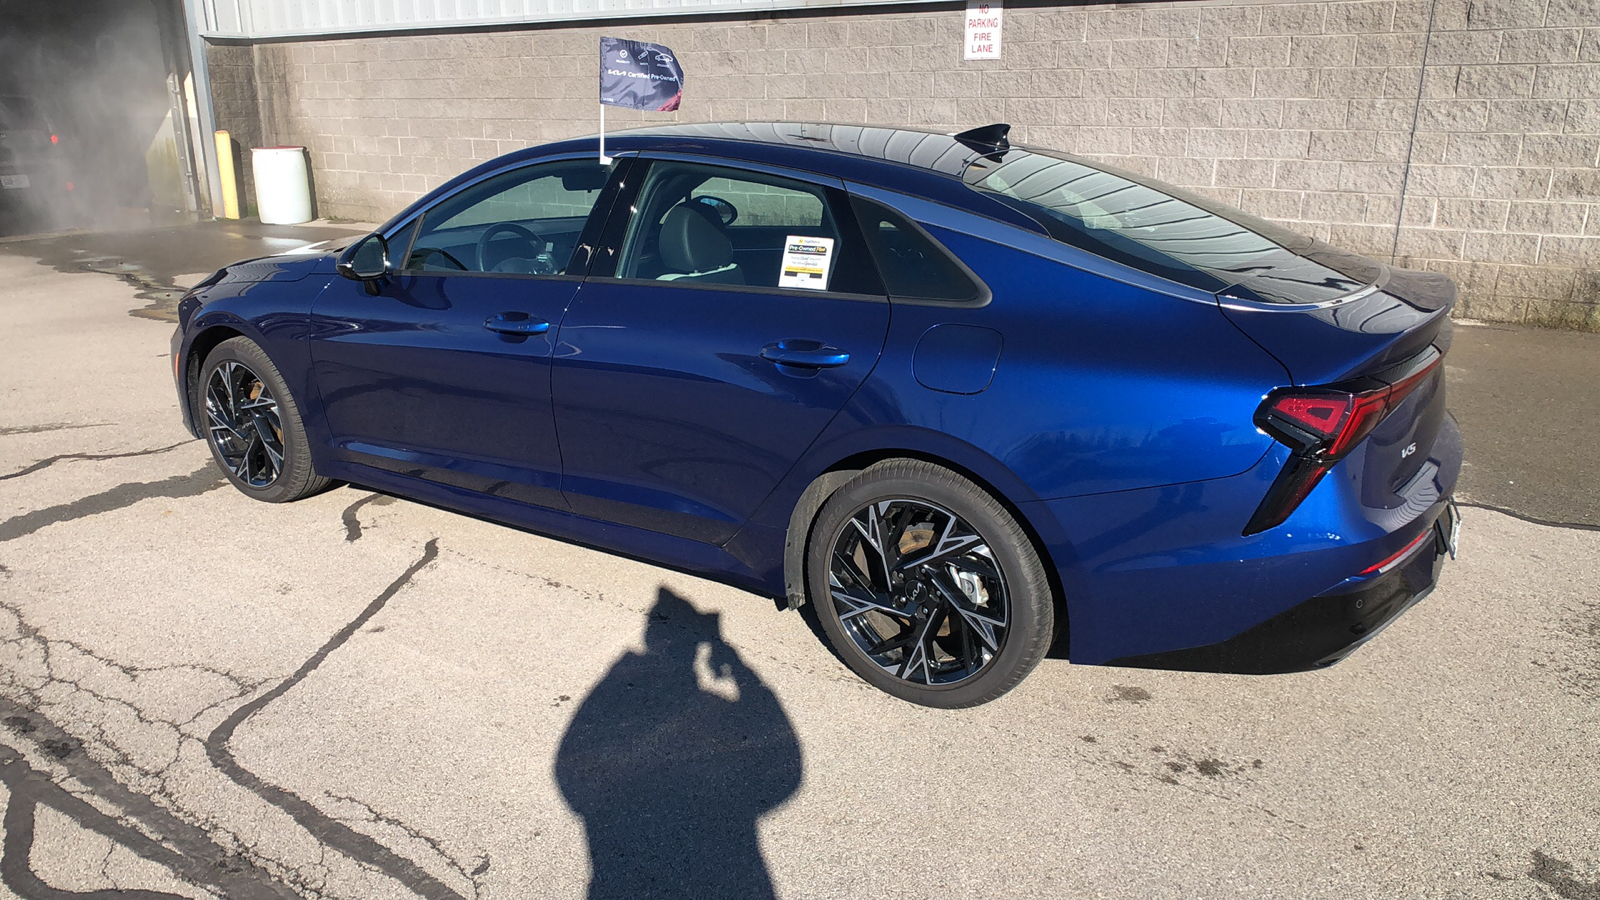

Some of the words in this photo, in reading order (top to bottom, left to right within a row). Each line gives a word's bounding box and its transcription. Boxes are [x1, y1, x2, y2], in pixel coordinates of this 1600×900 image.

[979, 4, 989, 14] NO
[968, 18, 998, 28] PARKING
[973, 32, 991, 41] FIRE
[971, 44, 993, 53] LANE
[628, 71, 650, 79] Certified
[650, 73, 675, 82] Pre-Owned
